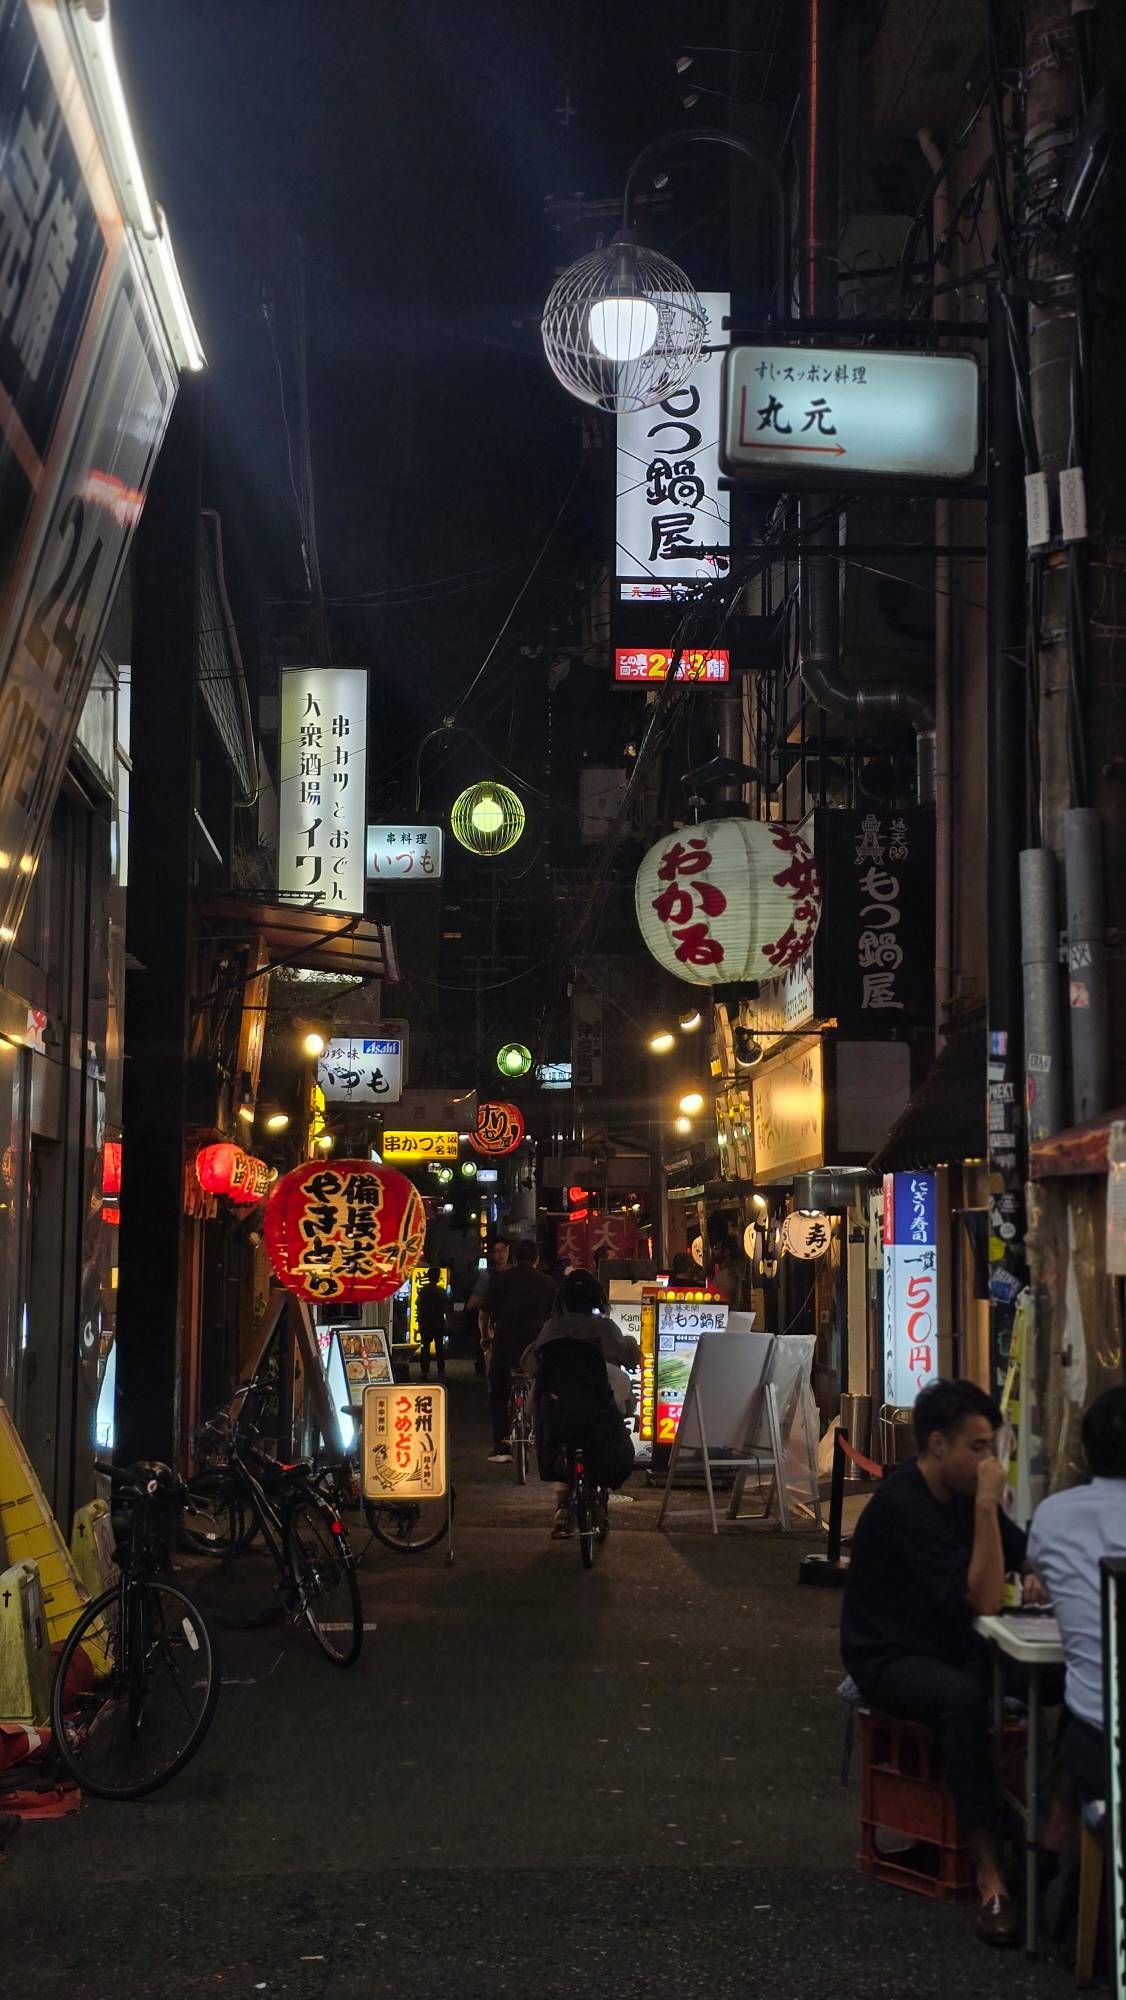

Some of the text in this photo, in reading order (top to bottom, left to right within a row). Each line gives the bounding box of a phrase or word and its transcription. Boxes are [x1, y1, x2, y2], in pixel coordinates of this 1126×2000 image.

[756, 394, 838, 435] 丸元
[329, 714, 350, 901] 串カツとおでん
[386, 832, 428, 845] 串料理
[374, 850, 434, 874] いづも
[652, 838, 727, 966] おかる
[858, 866, 905, 1009] もつ鍋屋
[366, 1041, 397, 1054] Asahi
[385, 1136, 433, 1152] 串かつ
[334, 1174, 381, 1275] 備長炭
[910, 1179, 928, 1243] にぎり寿司
[620, 1313, 640, 1322] Kam
[628, 1323, 640, 1331] Su
[675, 1312, 727, 1329] もつ鍋屋
[395, 1396, 413, 1468] うめどり
[415, 1395, 433, 1432] 紀州
